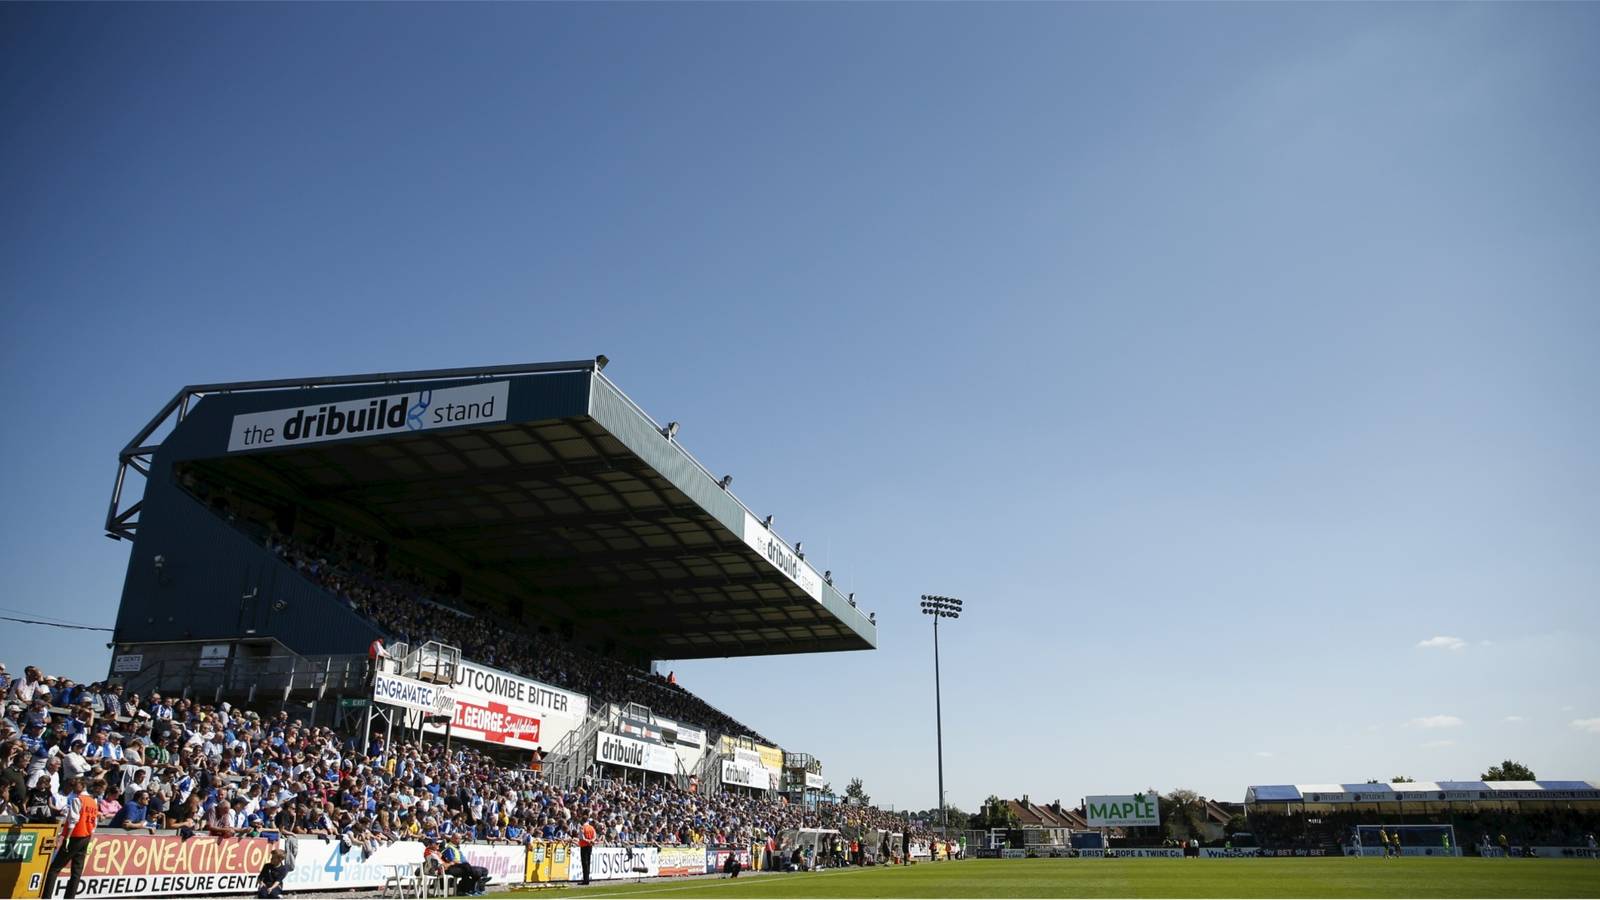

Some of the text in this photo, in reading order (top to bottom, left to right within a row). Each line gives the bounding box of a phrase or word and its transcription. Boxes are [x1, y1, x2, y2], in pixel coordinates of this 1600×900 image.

[243, 396, 496, 446] the dribuild stand
[767, 537, 798, 580] dribuild
[375, 676, 433, 706] ENGRAVATEC
[528, 685, 568, 713] BITTER
[464, 706, 504, 733] GEORGE
[602, 736, 644, 766] dribuild
[725, 763, 750, 785] dribuild
[1089, 801, 1156, 819] MAPLE
[1082, 848, 1104, 857] BRIST
[1145, 849, 1169, 857] TWINE
[151, 875, 215, 892] LEISURE
